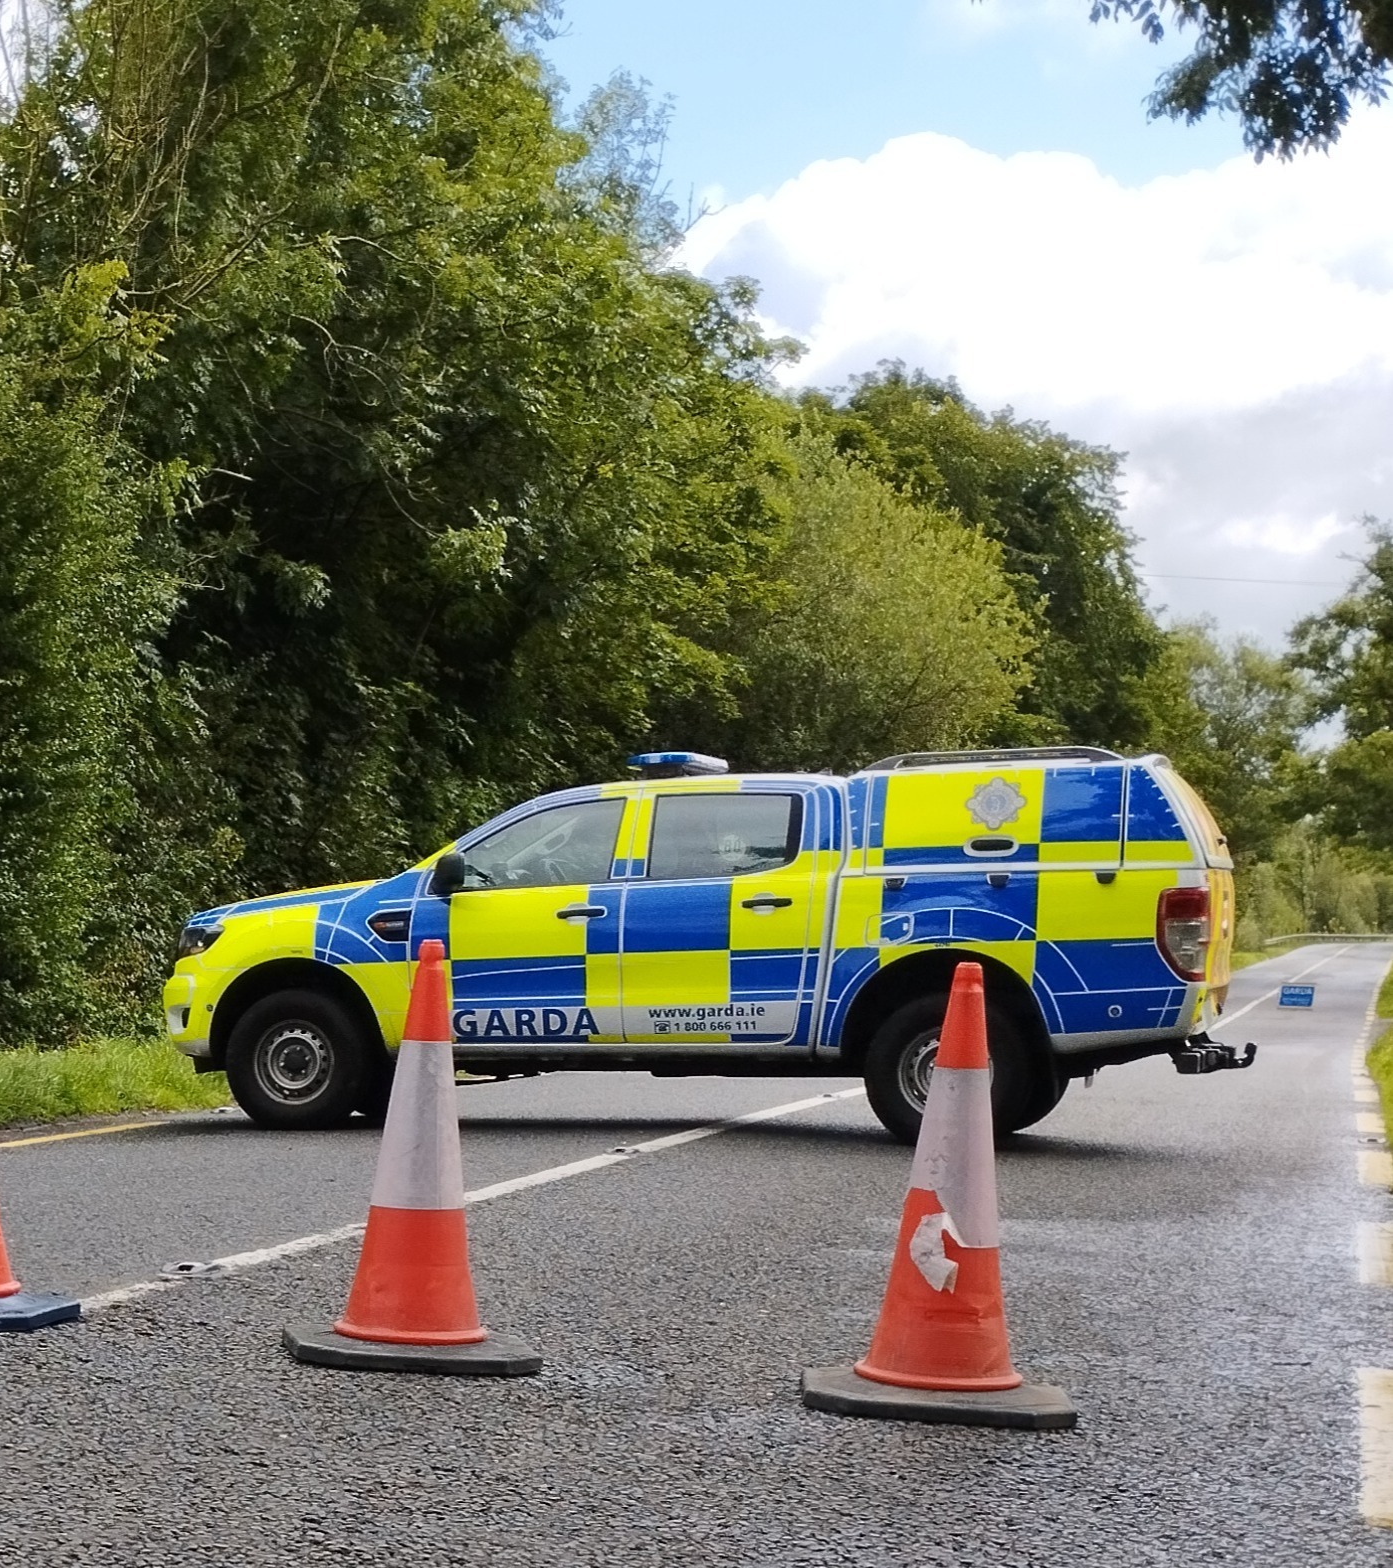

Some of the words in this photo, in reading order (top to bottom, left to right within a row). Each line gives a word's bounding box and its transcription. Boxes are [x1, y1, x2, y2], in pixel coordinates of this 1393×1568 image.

[648, 1003, 766, 1020] www.garda.ie
[452, 1008, 601, 1037] GARDA
[674, 1022, 680, 1031] 1
[684, 1021, 706, 1031] 800
[709, 1021, 732, 1031] 666
[736, 1020, 757, 1031] 111
